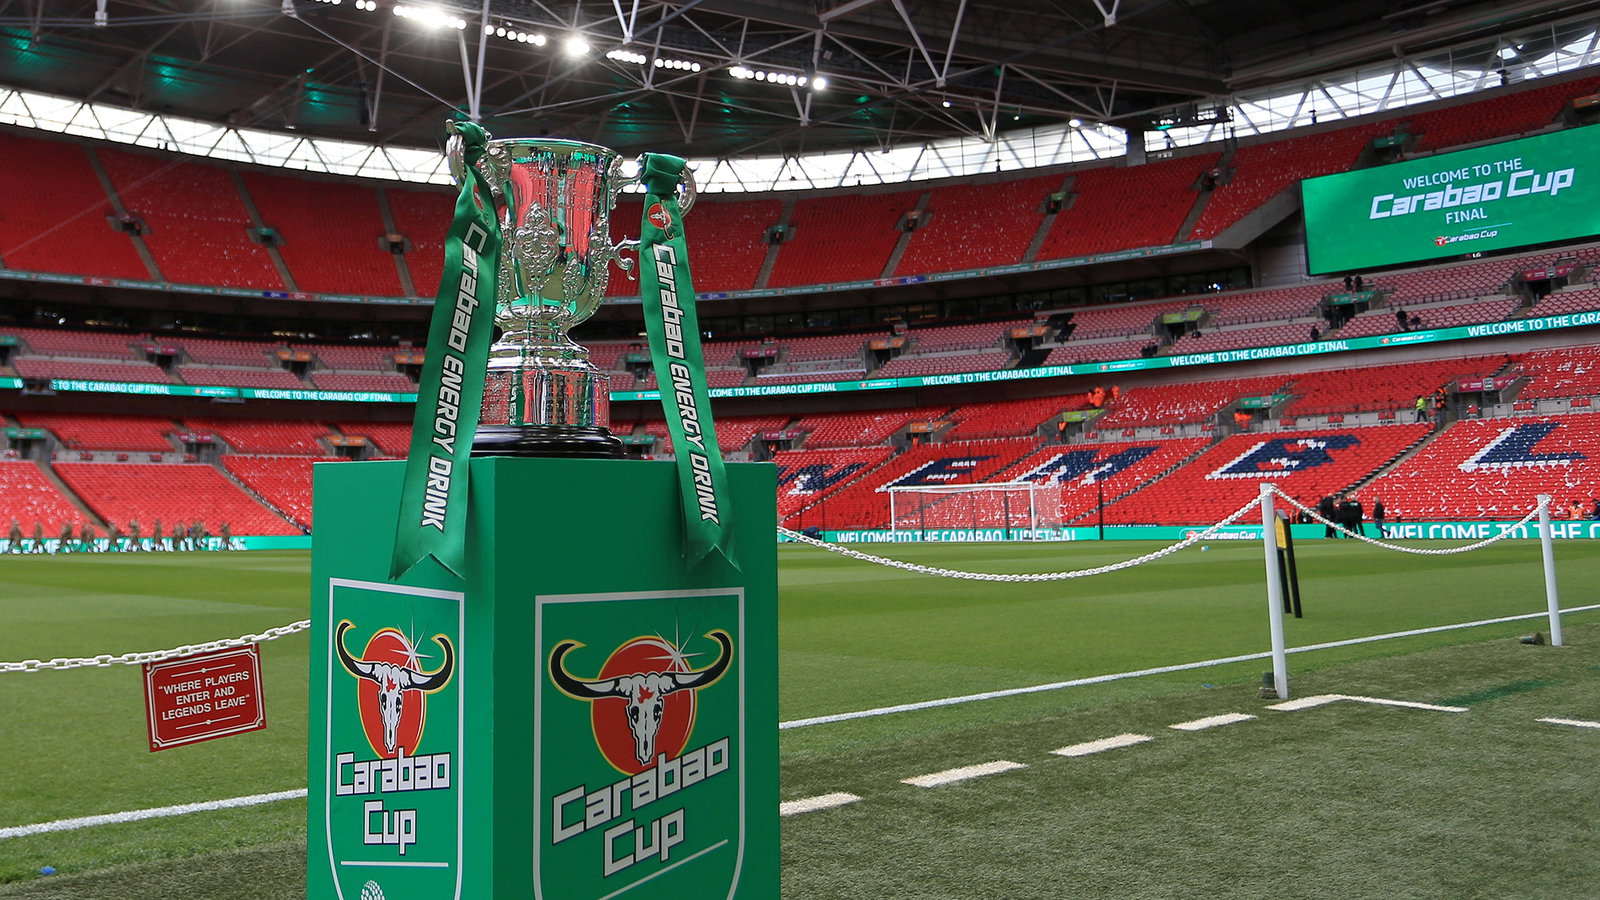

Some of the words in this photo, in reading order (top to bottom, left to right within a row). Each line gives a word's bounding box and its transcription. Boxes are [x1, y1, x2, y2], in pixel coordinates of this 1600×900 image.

[1403, 168, 1469, 190] WELCOME
[1472, 164, 1491, 178] TO
[1494, 158, 1522, 174] THE
[1369, 180, 1503, 220] Carabao
[1506, 168, 1575, 198] Cup
[1445, 207, 1488, 225] FINAL
[1480, 229, 1498, 240] Cup
[448, 222, 488, 353] Carabao
[1467, 320, 1525, 337] WELCOME
[1527, 318, 1543, 330] TO
[1544, 315, 1570, 329] THE
[1170, 353, 1215, 367] WELCOME
[1216, 352, 1229, 363] TO
[1230, 350, 1250, 361] THE
[1250, 346, 1296, 360] CARABAO
[1297, 344, 1316, 355] CUP
[1318, 340, 1349, 352] FINAL
[71, 381, 87, 391] THE
[652, 243, 686, 360] Carabao
[670, 363, 705, 452] ENERGY
[690, 452, 720, 526] DRINK
[922, 374, 961, 386] WELCOME
[963, 373, 973, 383] TO
[975, 372, 991, 382] THE
[992, 369, 1029, 380] CARABAO
[1031, 367, 1047, 378] CUP
[1048, 366, 1073, 376] FINAL
[254, 389, 291, 399] WELCOME
[292, 390, 302, 400] TO
[303, 390, 318, 400] THE
[319, 391, 353, 401] CARABAO
[353, 391, 369, 401] CUP
[370, 392, 392, 402] FINAL
[708, 387, 732, 398] LCOME
[734, 387, 743, 397] TO
[744, 386, 760, 396] THE
[761, 385, 796, 395] CARABAO
[797, 384, 812, 394] CUP
[814, 383, 837, 392] FINAL
[433, 354, 464, 455] ENERGY
[421, 456, 453, 532] DRINK
[895, 531, 911, 543] TO
[205, 671, 250, 688] PLAYERS
[176, 690, 210, 706] ENTER
[214, 686, 235, 699] AND
[162, 703, 211, 720] LEGENDS
[336, 746, 450, 796] Carabao
[552, 736, 730, 846] Carabao
[363, 800, 417, 856] Cup
[603, 807, 685, 879] Cup
